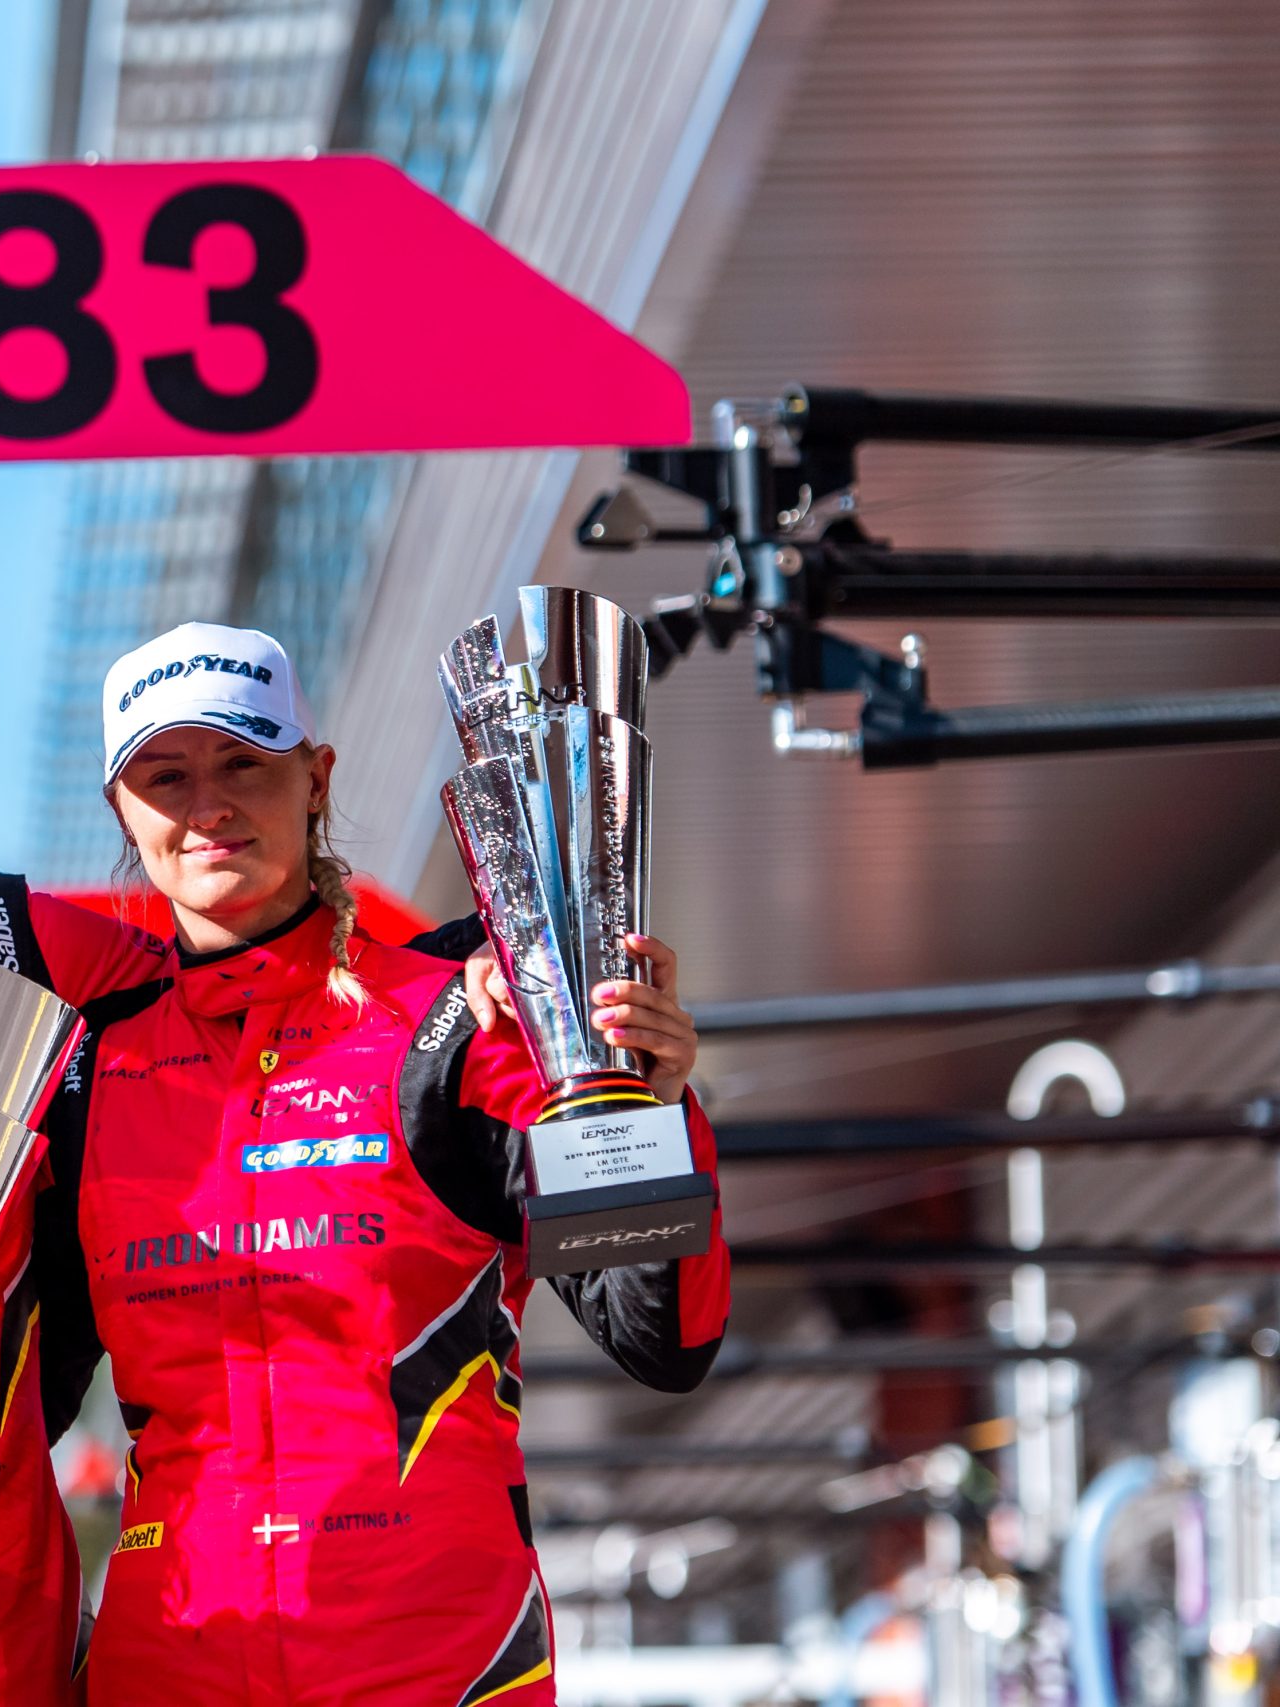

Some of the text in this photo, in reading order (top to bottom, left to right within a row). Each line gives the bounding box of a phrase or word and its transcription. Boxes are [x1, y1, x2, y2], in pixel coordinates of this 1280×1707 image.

[119, 654, 273, 712] GOODYEAR
[417, 984, 467, 1052] Sabelt
[246, 1141, 384, 1168] GOODYAR
[586, 1146, 632, 1157] SEPTEMBER
[597, 1156, 630, 1167] LM GTE
[601, 1164, 645, 1176] POSITION
[125, 1213, 386, 1273] IRON DAMES
[126, 1288, 176, 1305] WOMEN
[181, 1279, 233, 1297] DRIVEN
[239, 1275, 257, 1288] BY
[323, 1512, 388, 1533] GATTING
[120, 1526, 159, 1549] Sabelt
